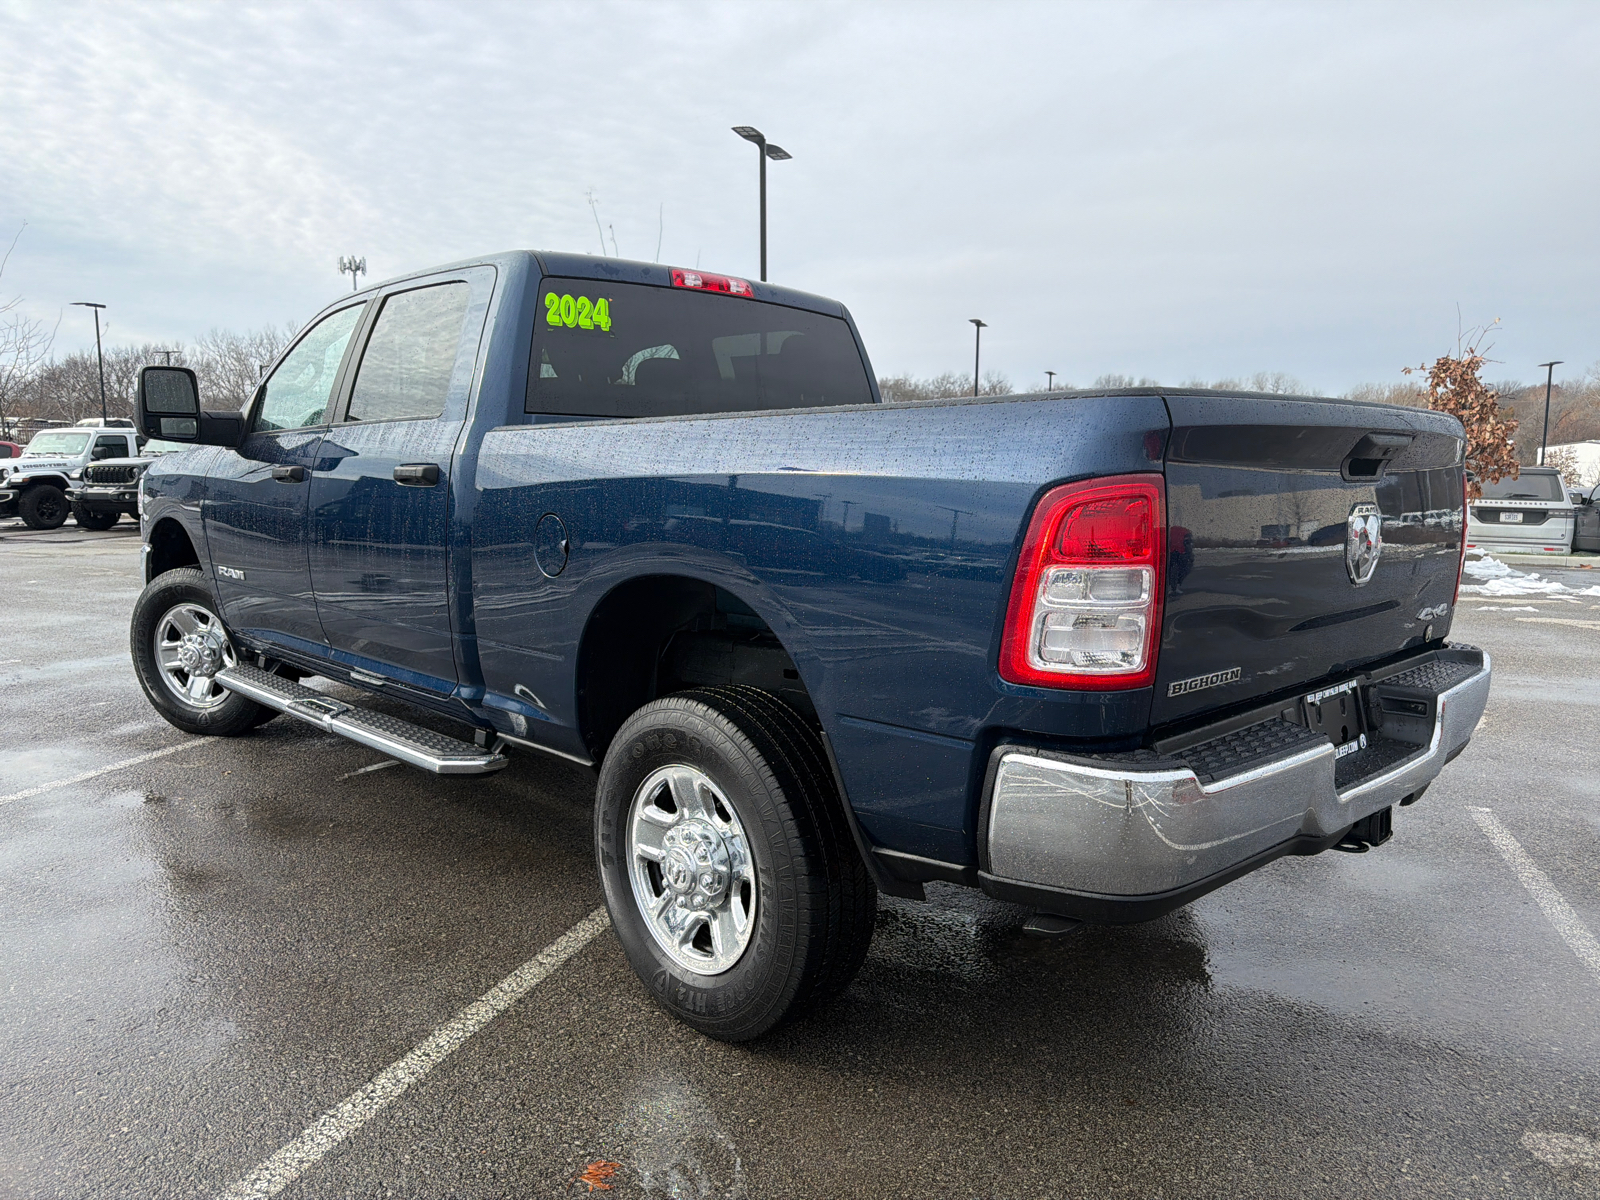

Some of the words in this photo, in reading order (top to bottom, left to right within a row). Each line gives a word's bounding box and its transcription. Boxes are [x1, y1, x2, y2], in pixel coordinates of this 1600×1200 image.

[545, 292, 611, 331] 2024
[1357, 506, 1376, 515] RAM
[217, 565, 246, 581] RAM
[1168, 668, 1241, 696] BIGHORN
